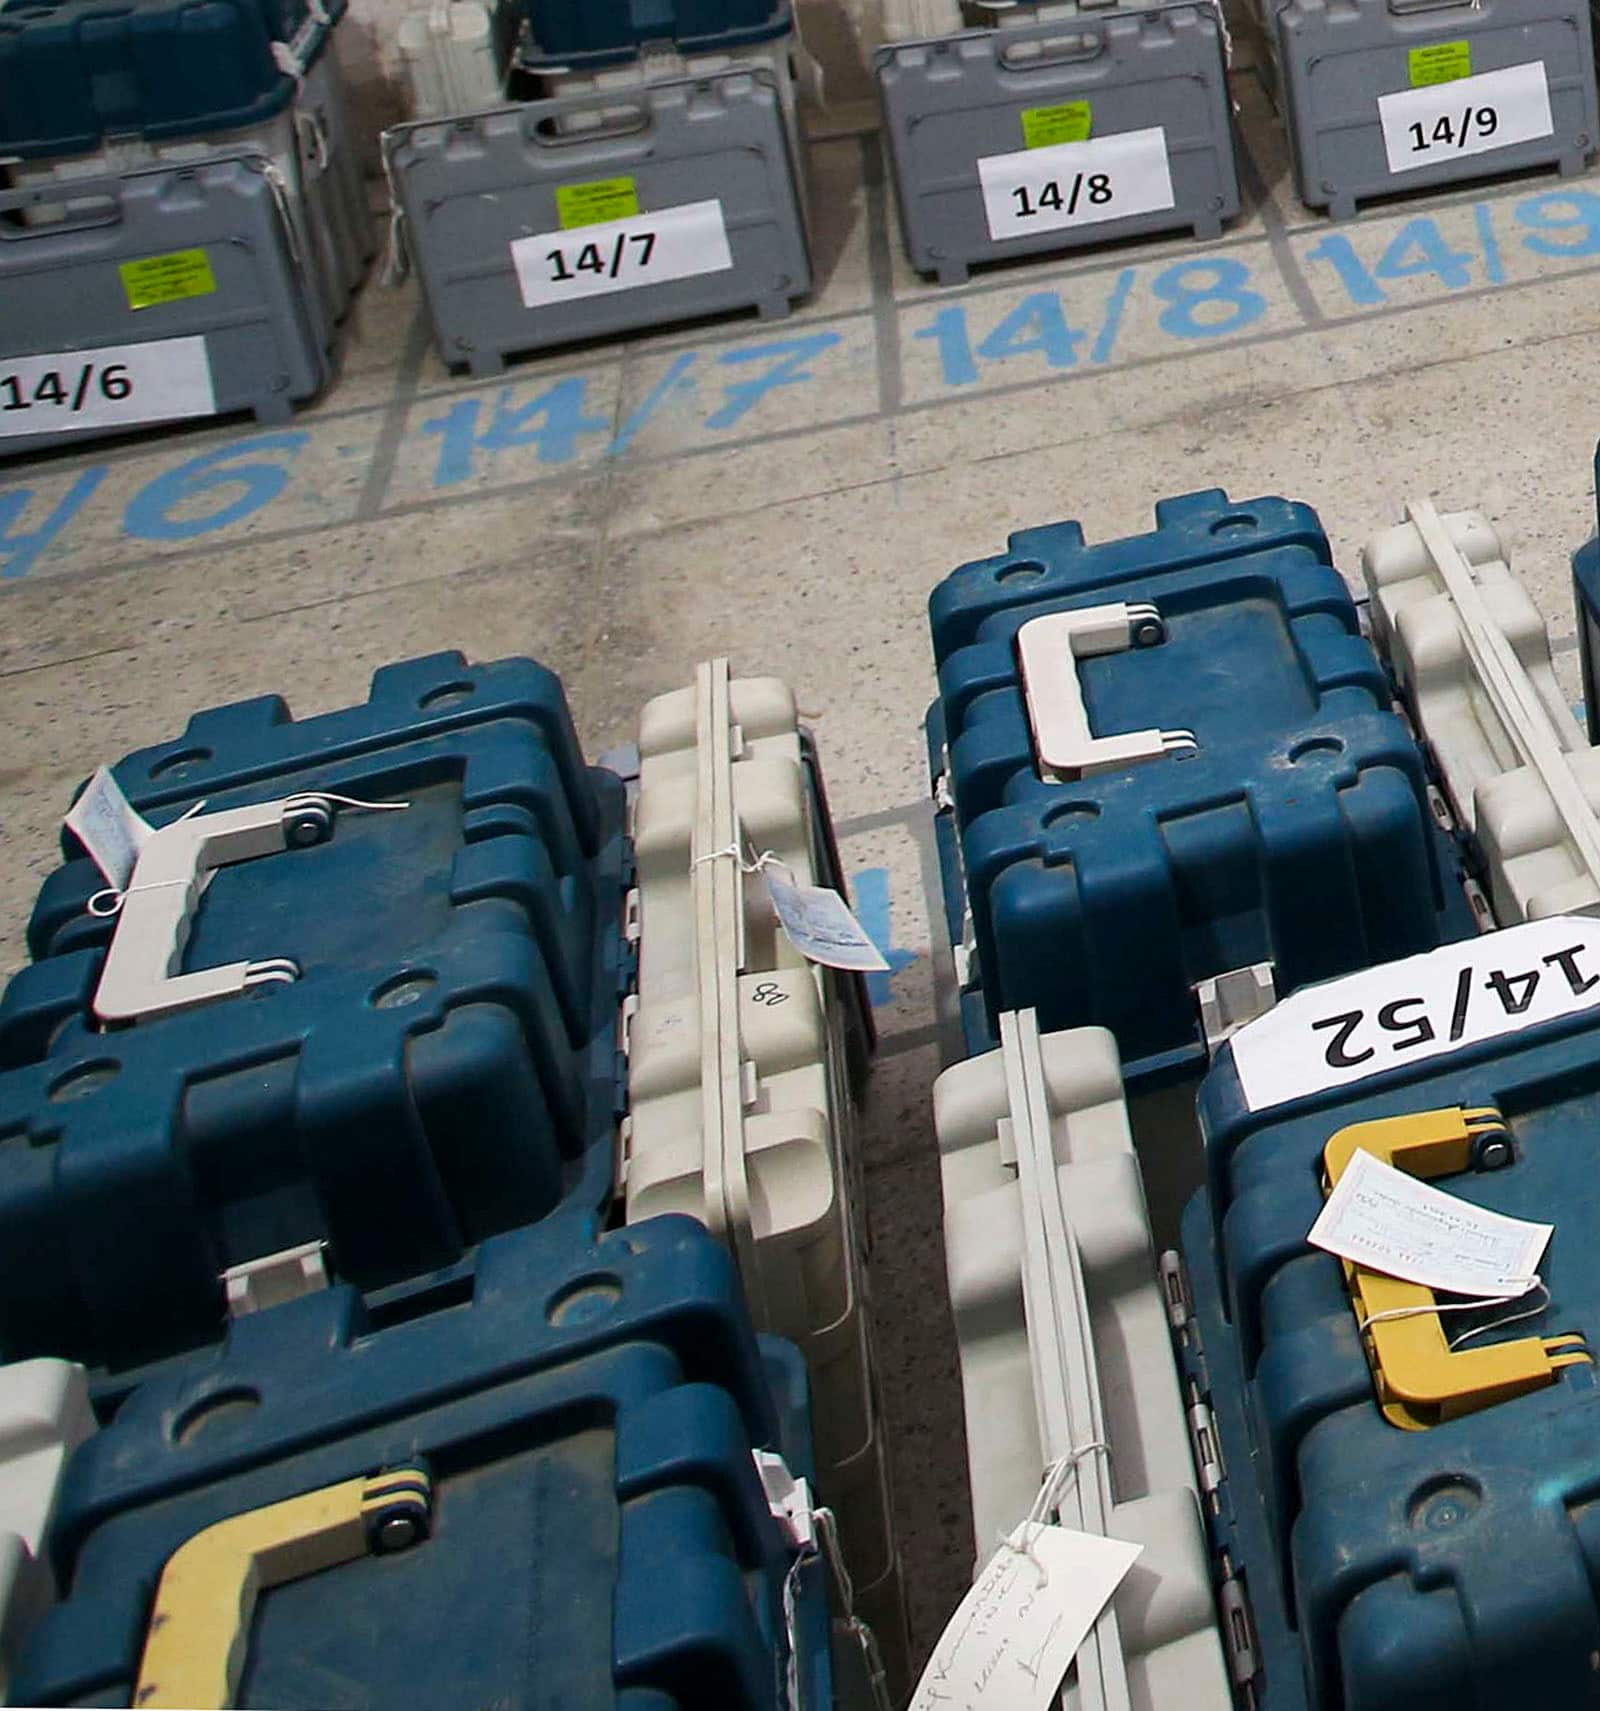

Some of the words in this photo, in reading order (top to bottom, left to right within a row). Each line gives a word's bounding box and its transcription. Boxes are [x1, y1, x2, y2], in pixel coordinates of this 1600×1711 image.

[1407, 105, 1499, 153] 14/9
[1012, 172, 1113, 219] 14/8
[545, 231, 657, 282] 14/7
[914, 256, 1269, 387] 14/8
[0, 363, 134, 412] 14/6
[420, 331, 843, 488] 14/7
